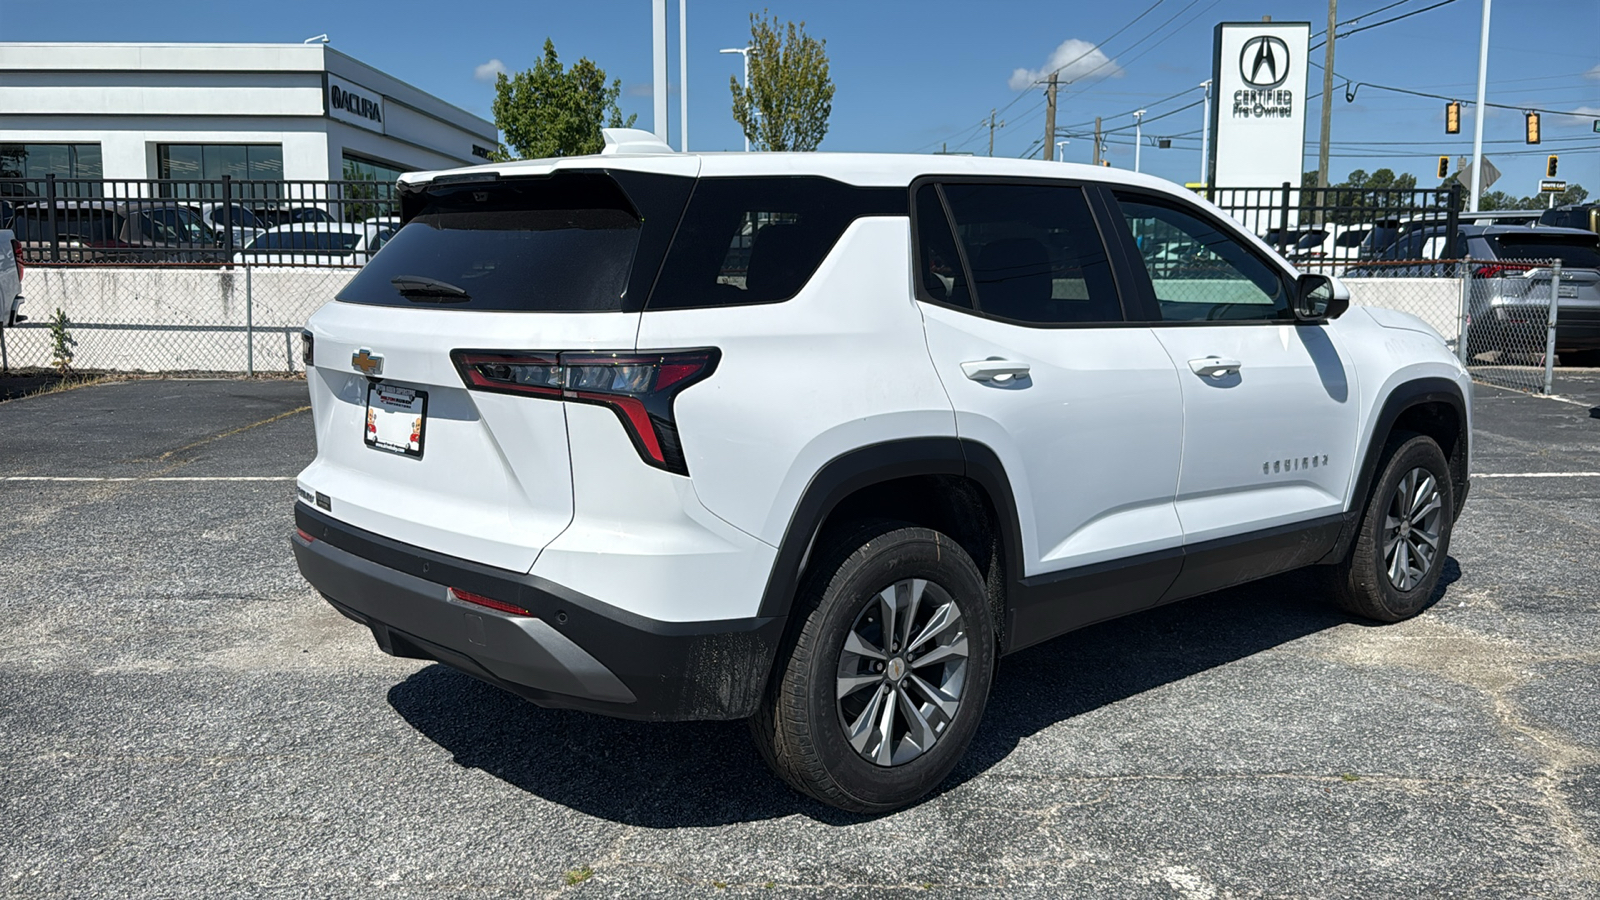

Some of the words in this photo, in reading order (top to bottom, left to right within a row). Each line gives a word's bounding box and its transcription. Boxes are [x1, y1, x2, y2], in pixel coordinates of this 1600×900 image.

[341, 91, 382, 123] ACURA
[1234, 90, 1292, 106] CERTIFIED
[1233, 103, 1292, 118] Pre-Owned
[1262, 454, 1329, 475] EQUINOX
